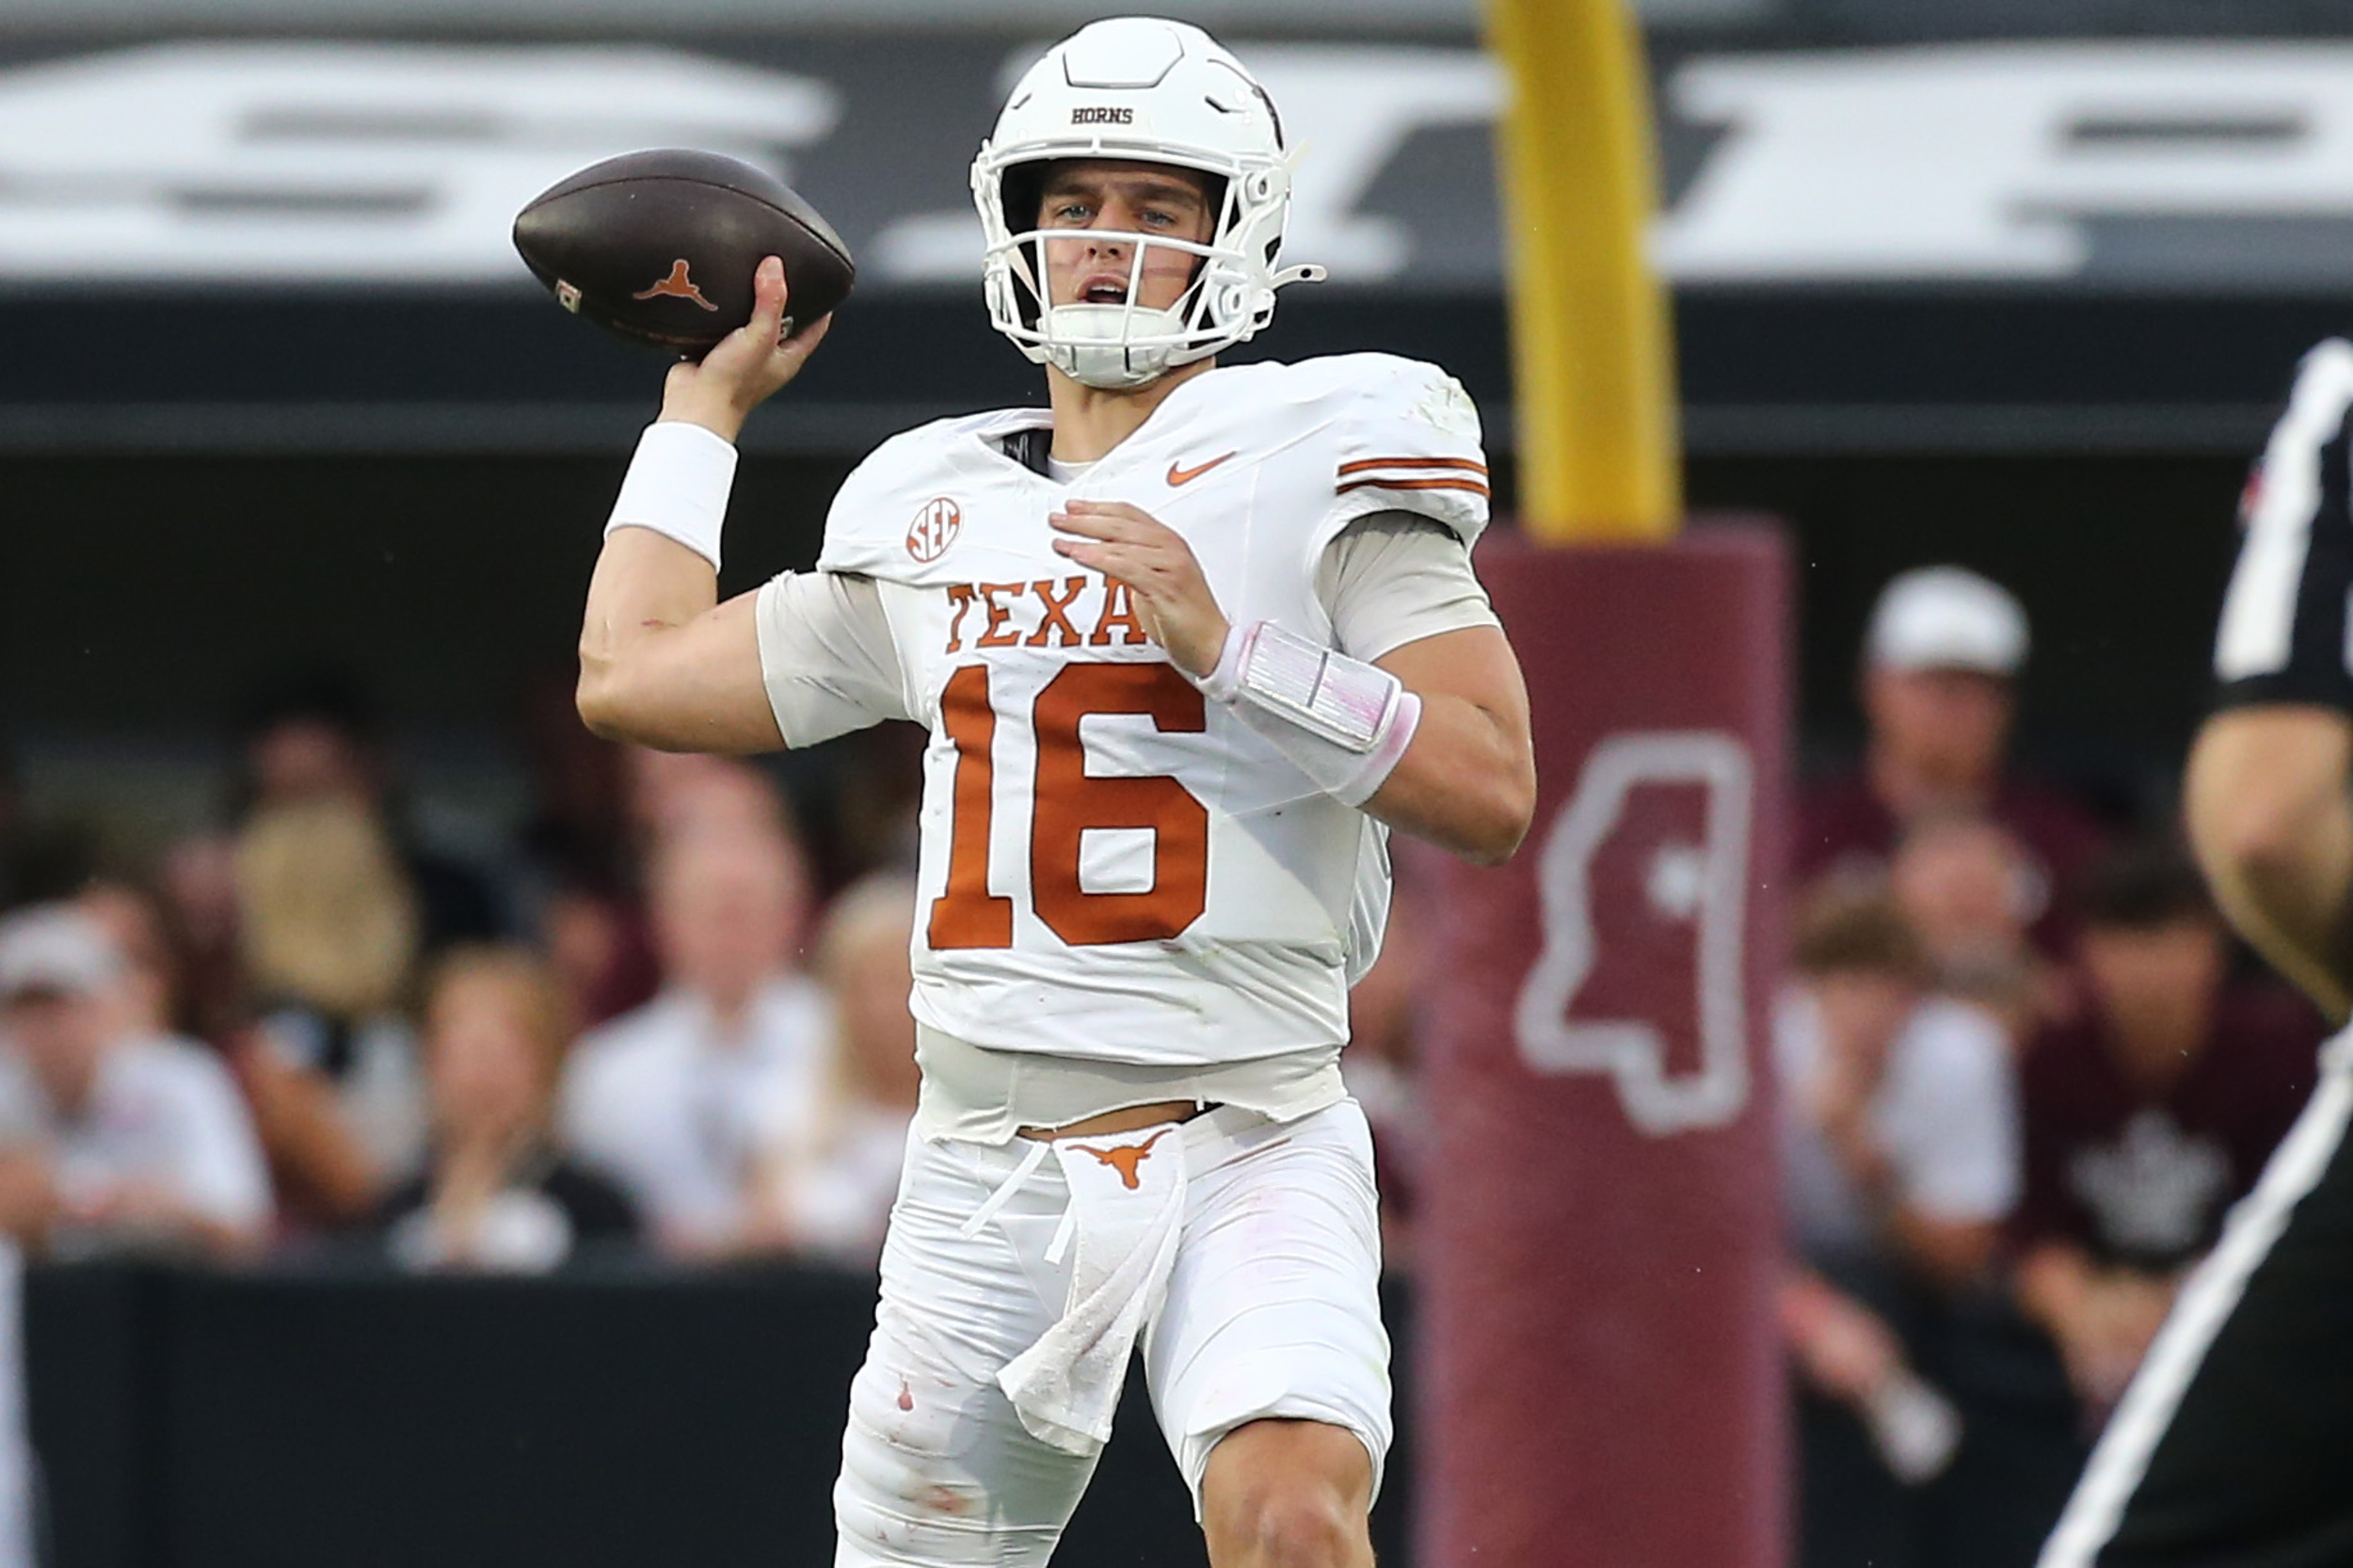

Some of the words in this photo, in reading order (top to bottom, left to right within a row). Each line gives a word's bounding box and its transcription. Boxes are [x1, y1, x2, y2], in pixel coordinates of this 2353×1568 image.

[1071, 106, 1134, 125] HORNS
[907, 498, 959, 563] SEC
[946, 575, 1146, 654] TEXA
[928, 662, 1209, 950] 16
